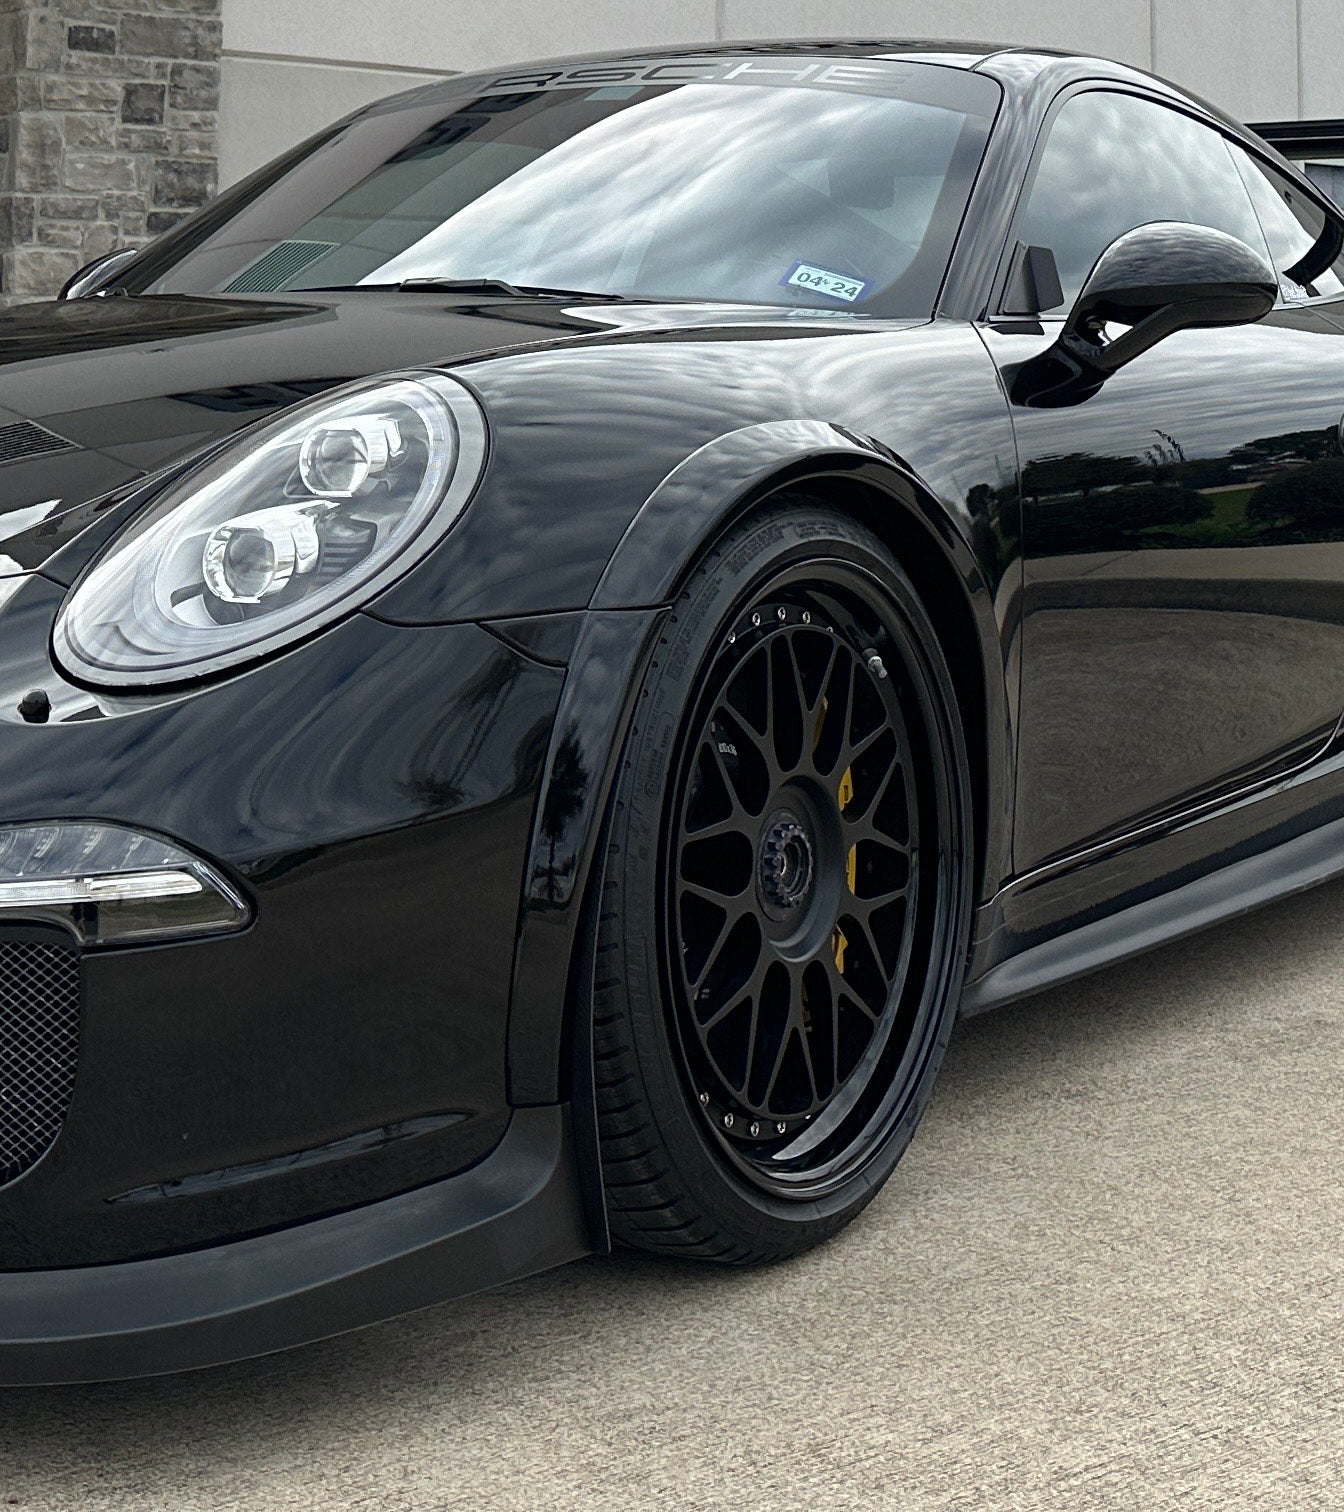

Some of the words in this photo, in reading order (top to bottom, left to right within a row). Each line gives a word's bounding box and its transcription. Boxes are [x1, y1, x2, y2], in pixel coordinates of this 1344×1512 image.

[416, 62, 912, 94] RSCHE
[797, 272, 824, 287] 04
[830, 281, 858, 298] 24
